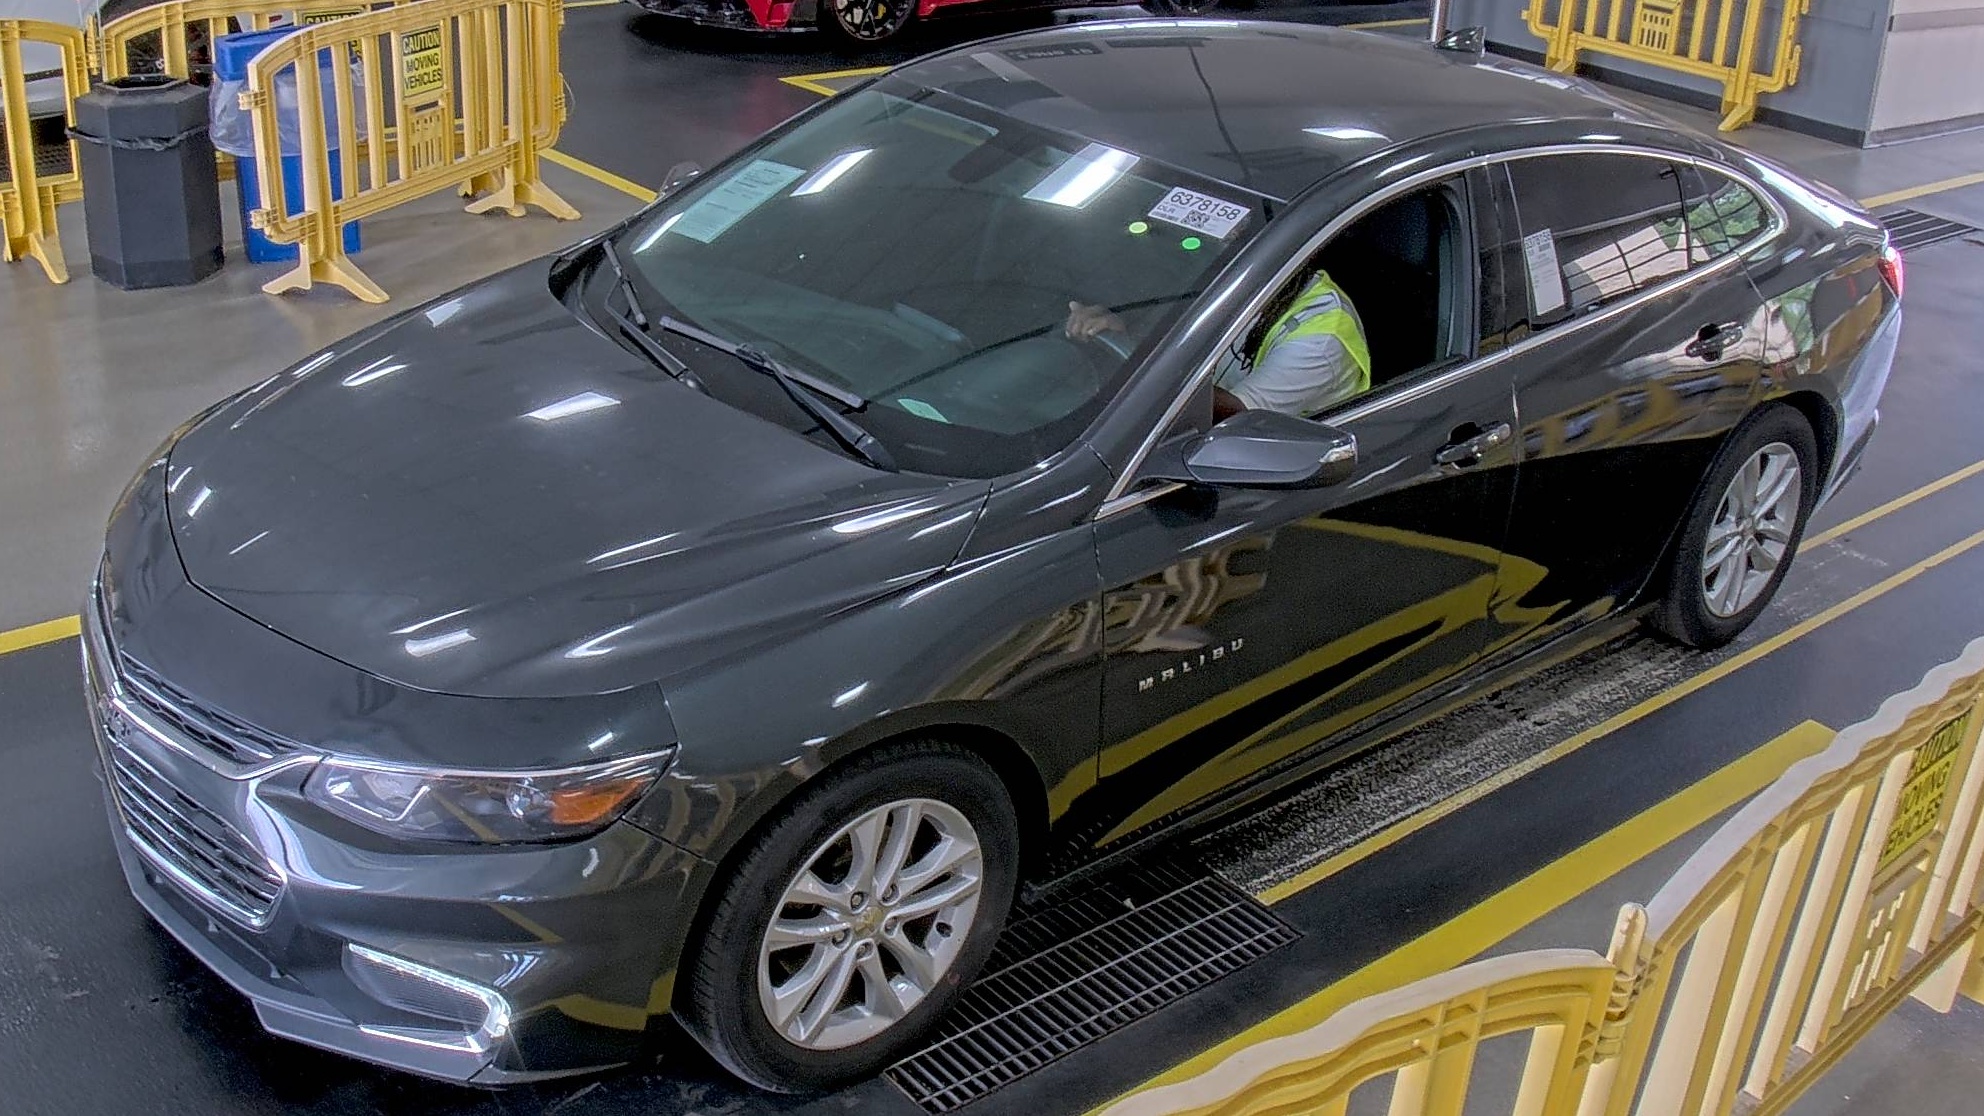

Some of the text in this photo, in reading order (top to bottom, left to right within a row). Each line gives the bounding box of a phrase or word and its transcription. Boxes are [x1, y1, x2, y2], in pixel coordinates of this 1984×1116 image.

[307, 13, 358, 25] CAUT
[402, 30, 441, 54] CAUTION
[405, 52, 440, 74] MOVING
[404, 69, 443, 89] VEHICLES
[1170, 191, 1241, 220] 6378158
[1138, 638, 1244, 693] MALIBU
[1900, 760, 1951, 814] OVING
[1884, 792, 1943, 856] EHICLES
